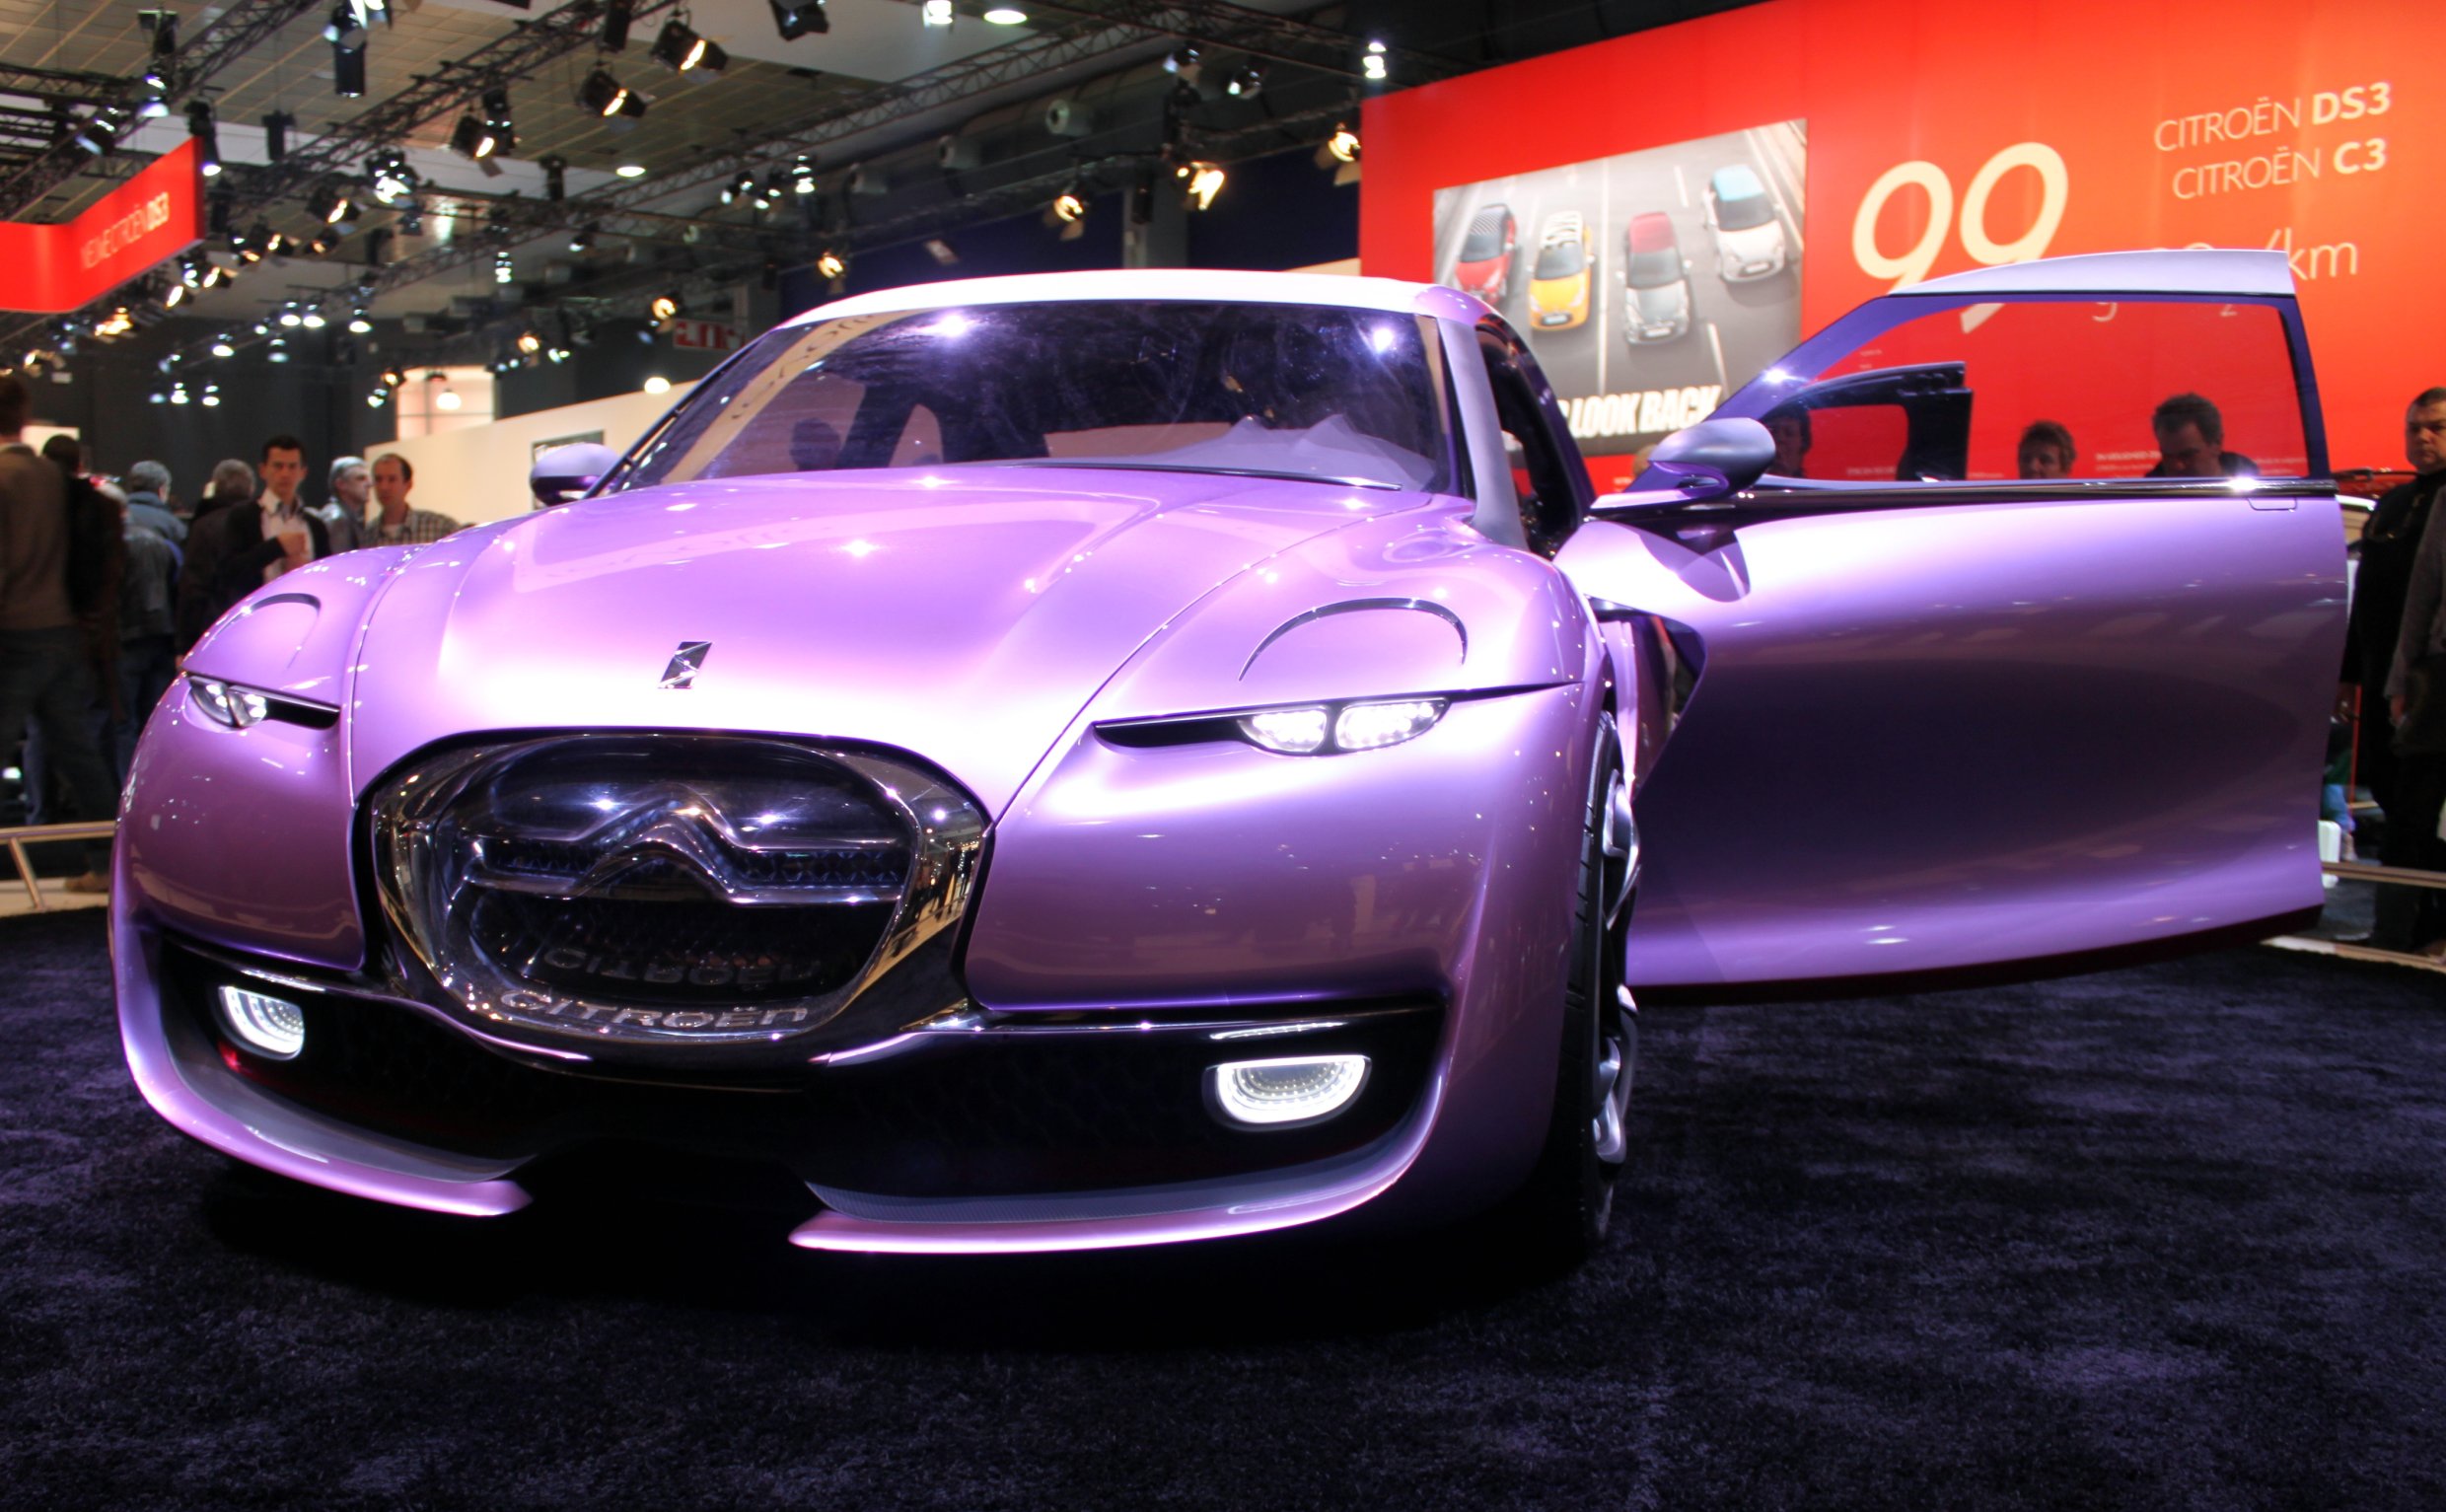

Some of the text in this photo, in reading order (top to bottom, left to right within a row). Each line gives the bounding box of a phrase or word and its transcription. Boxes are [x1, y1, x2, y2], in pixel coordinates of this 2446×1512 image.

[2154, 82, 2391, 151] CITROËN DS3
[2173, 138, 2387, 199] CITROËN C3
[1852, 142, 2068, 333] 99
[1570, 393, 1641, 438] LOOK
[1638, 385, 1723, 434] BACK
